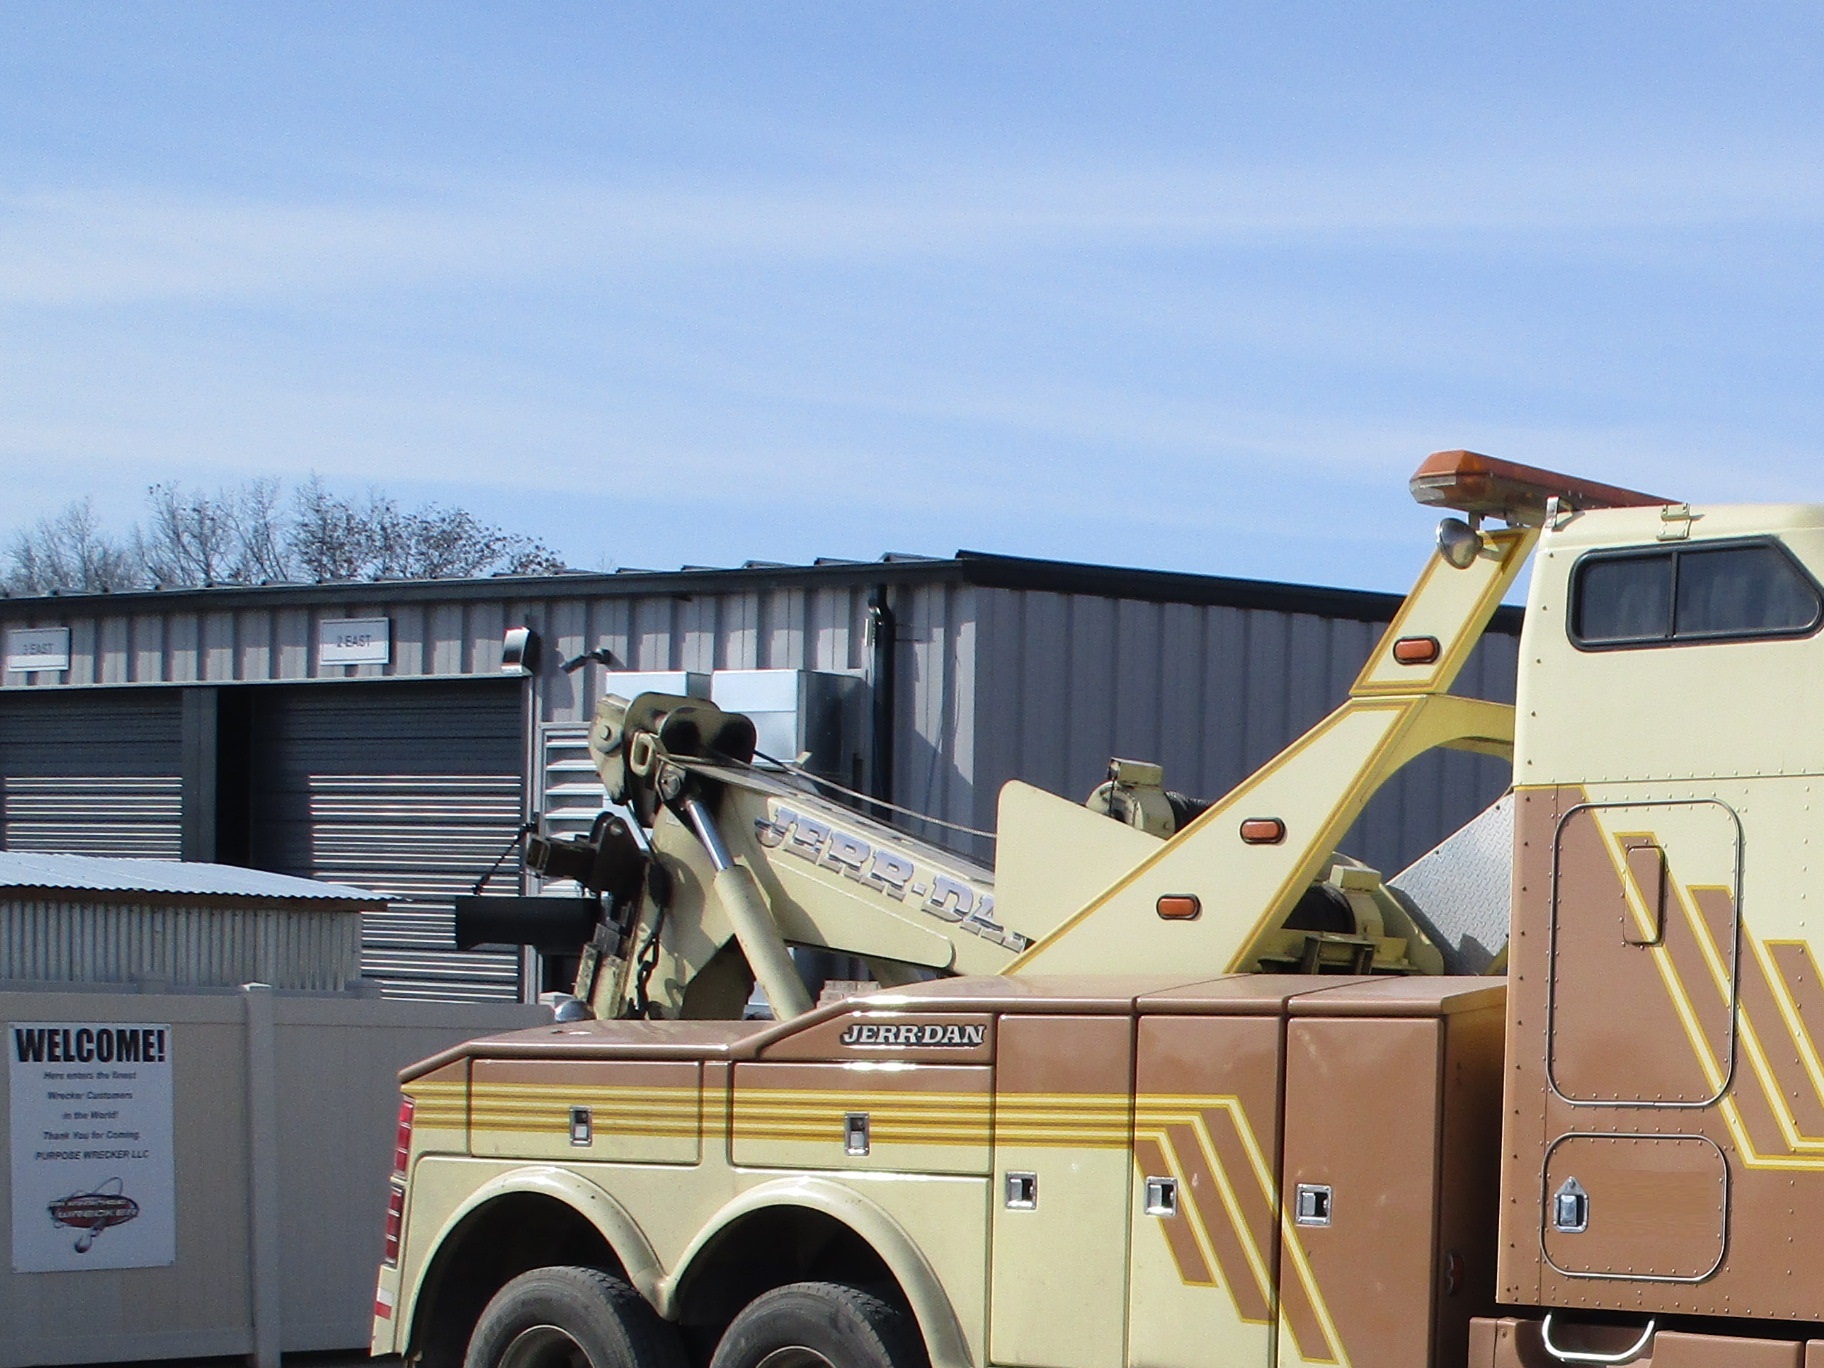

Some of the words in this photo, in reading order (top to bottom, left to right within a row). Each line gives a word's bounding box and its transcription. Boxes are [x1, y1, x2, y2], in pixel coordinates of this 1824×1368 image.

[345, 634, 371, 648] EAST
[30, 643, 54, 655] EAST
[15, 1027, 166, 1063] WELCOME!
[35, 1151, 81, 1160] PURPOSE
[83, 1150, 130, 1160] WRECKER
[131, 1149, 149, 1159] LLC
